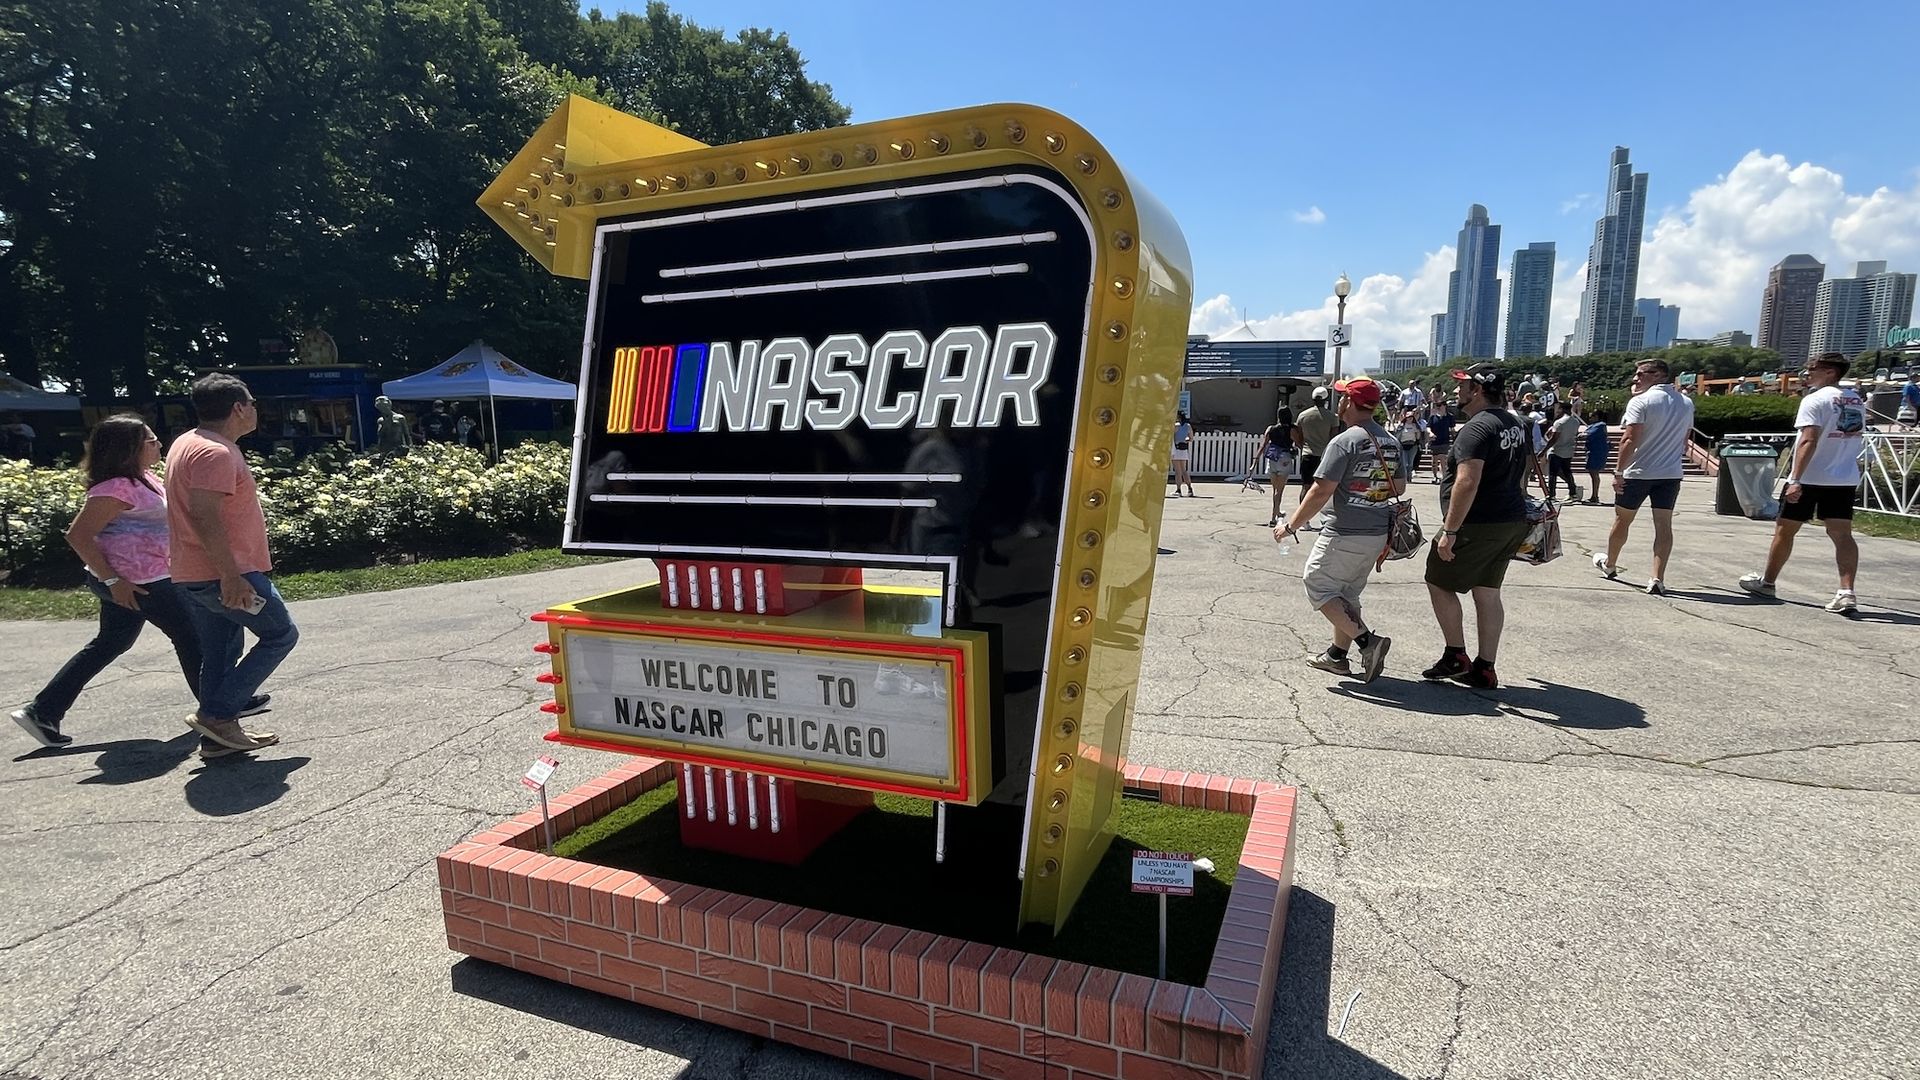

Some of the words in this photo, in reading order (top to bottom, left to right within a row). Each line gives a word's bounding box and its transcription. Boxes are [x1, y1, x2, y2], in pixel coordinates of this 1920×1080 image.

[699, 321, 1057, 432] NASCAR
[1539, 393, 1554, 408] 99
[641, 658, 777, 700] WELCOME
[817, 674, 856, 708] TO
[614, 697, 725, 739] NASCAR
[747, 712, 886, 759] CHICAGO
[1137, 850, 1148, 858] DO
[1149, 851, 1163, 859] NOT
[1165, 852, 1189, 860] TOUCH
[1140, 875, 1185, 885] CHAMPIONSHIPS
